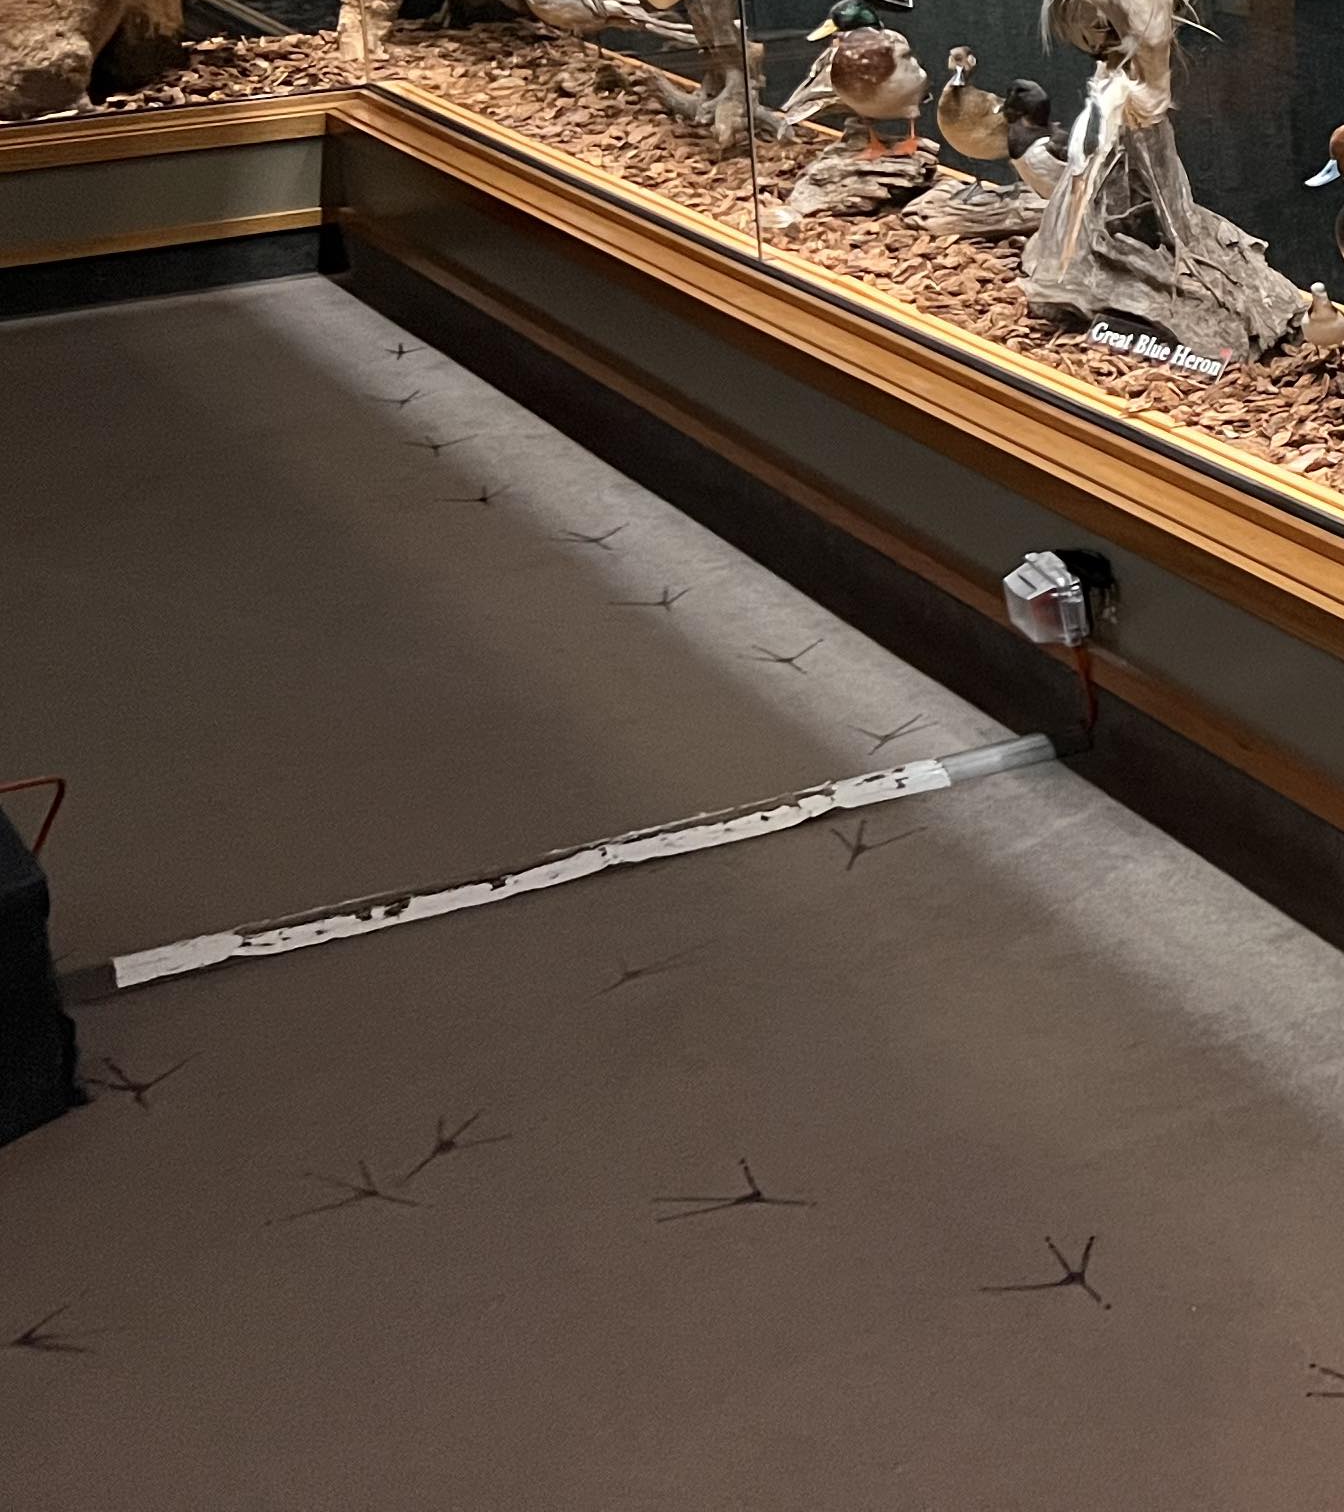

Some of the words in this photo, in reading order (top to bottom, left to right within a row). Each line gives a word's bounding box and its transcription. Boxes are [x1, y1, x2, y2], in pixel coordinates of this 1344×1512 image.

[1091, 321, 1134, 350] Great
[1134, 333, 1171, 361] Blue
[1170, 344, 1223, 377] Heron
